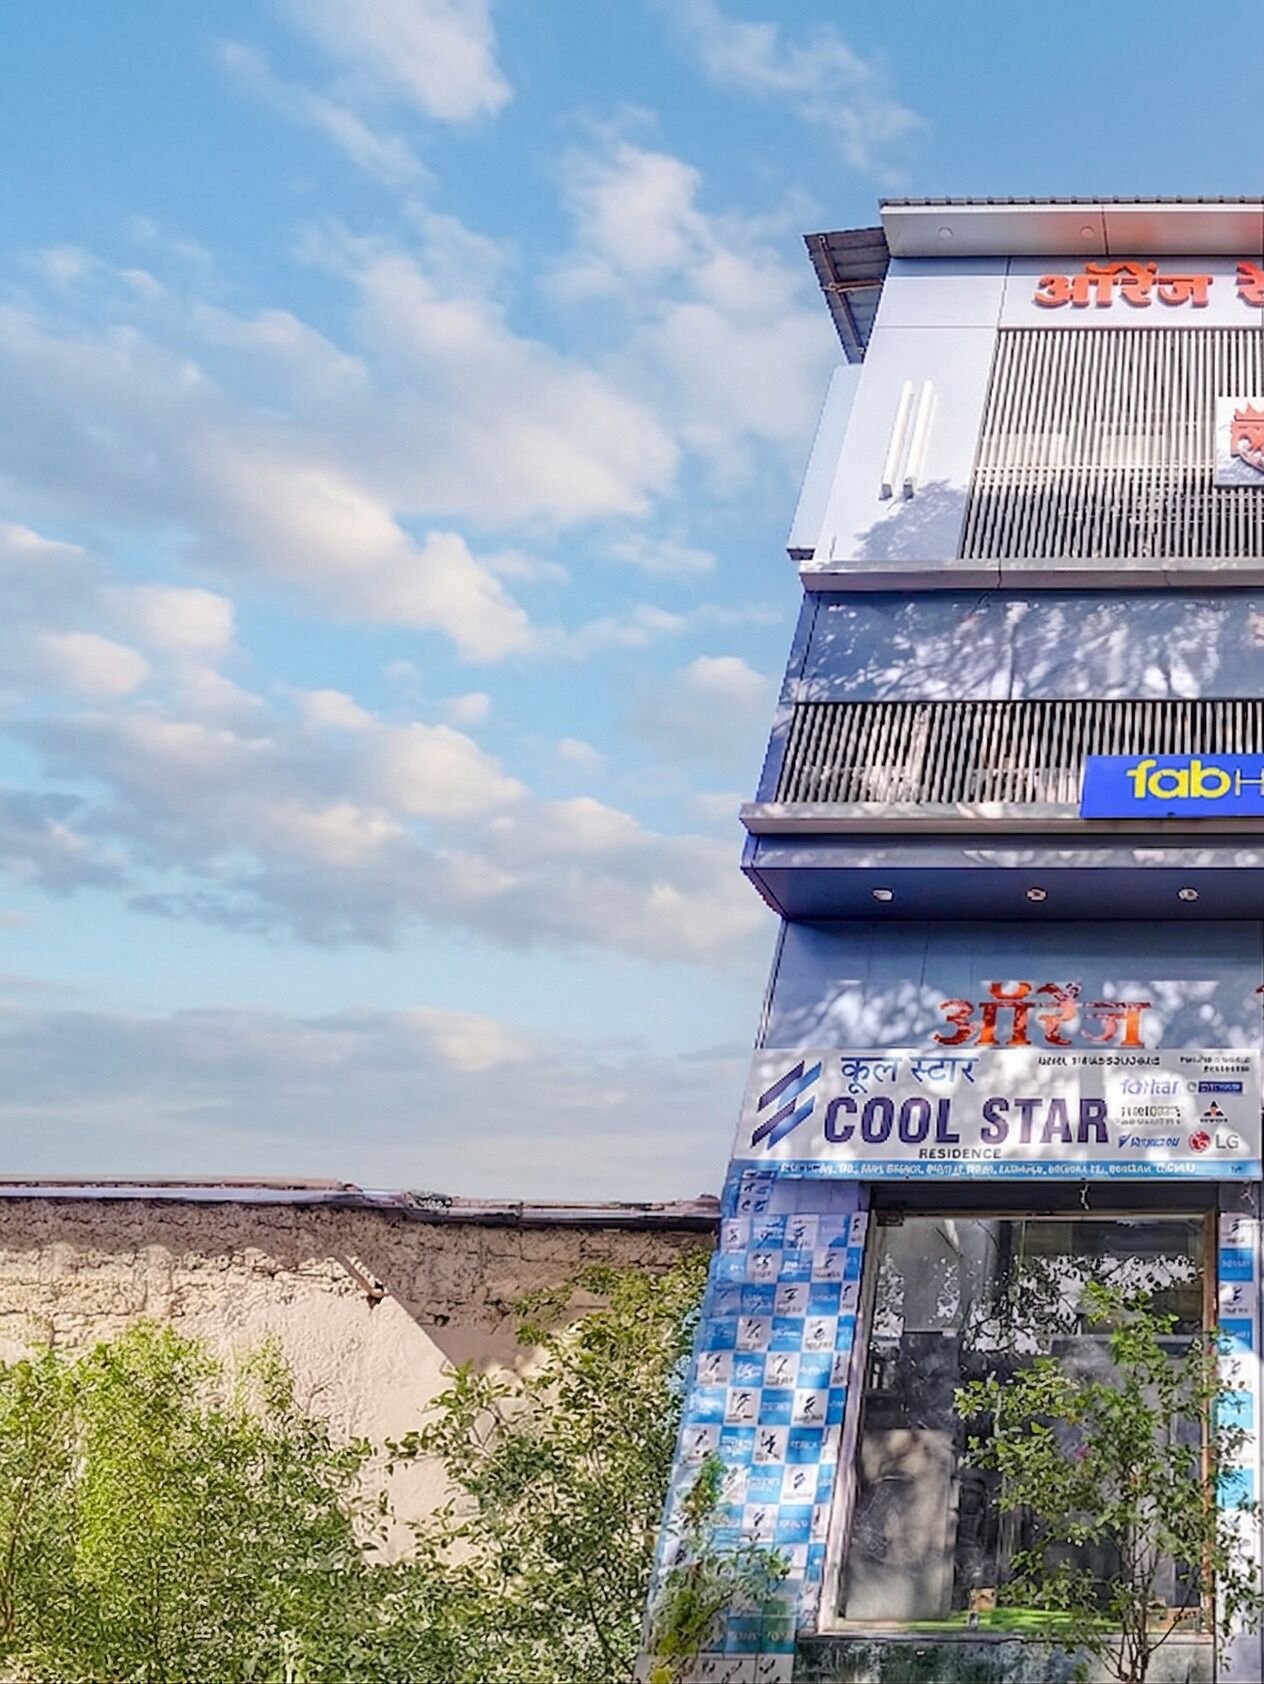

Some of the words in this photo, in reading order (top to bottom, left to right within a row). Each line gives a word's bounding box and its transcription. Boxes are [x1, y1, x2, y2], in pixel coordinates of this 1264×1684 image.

[841, 1056, 902, 1094] कूल
[910, 1056, 979, 1083] स्टार
[824, 1096, 960, 1144] COOL
[980, 1097, 1110, 1144] STAR
[919, 1148, 1001, 1159] RESIDENCE
[1215, 1133, 1240, 1150] LG
